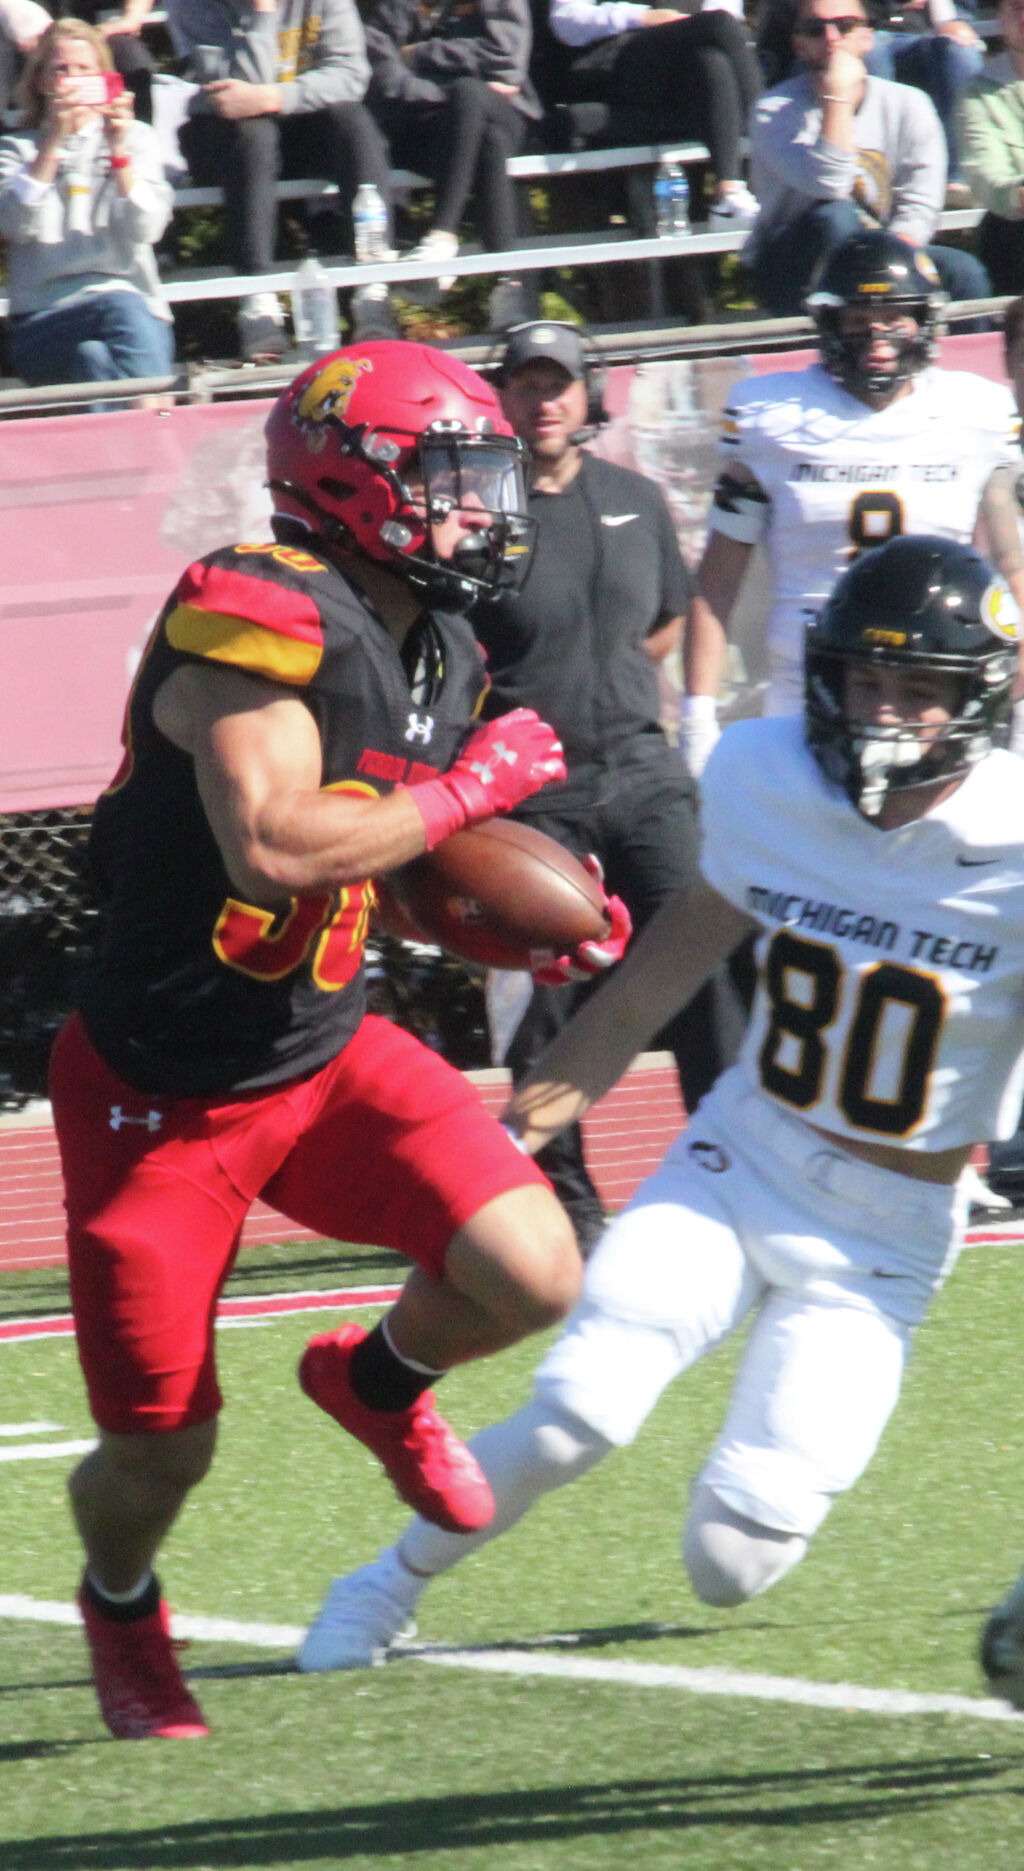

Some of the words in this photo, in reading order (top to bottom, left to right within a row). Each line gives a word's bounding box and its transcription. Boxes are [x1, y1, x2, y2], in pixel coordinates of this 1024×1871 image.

[748, 885, 901, 950] MICHIGAN
[910, 930, 998, 973] TECH
[758, 928, 950, 1139] 80
